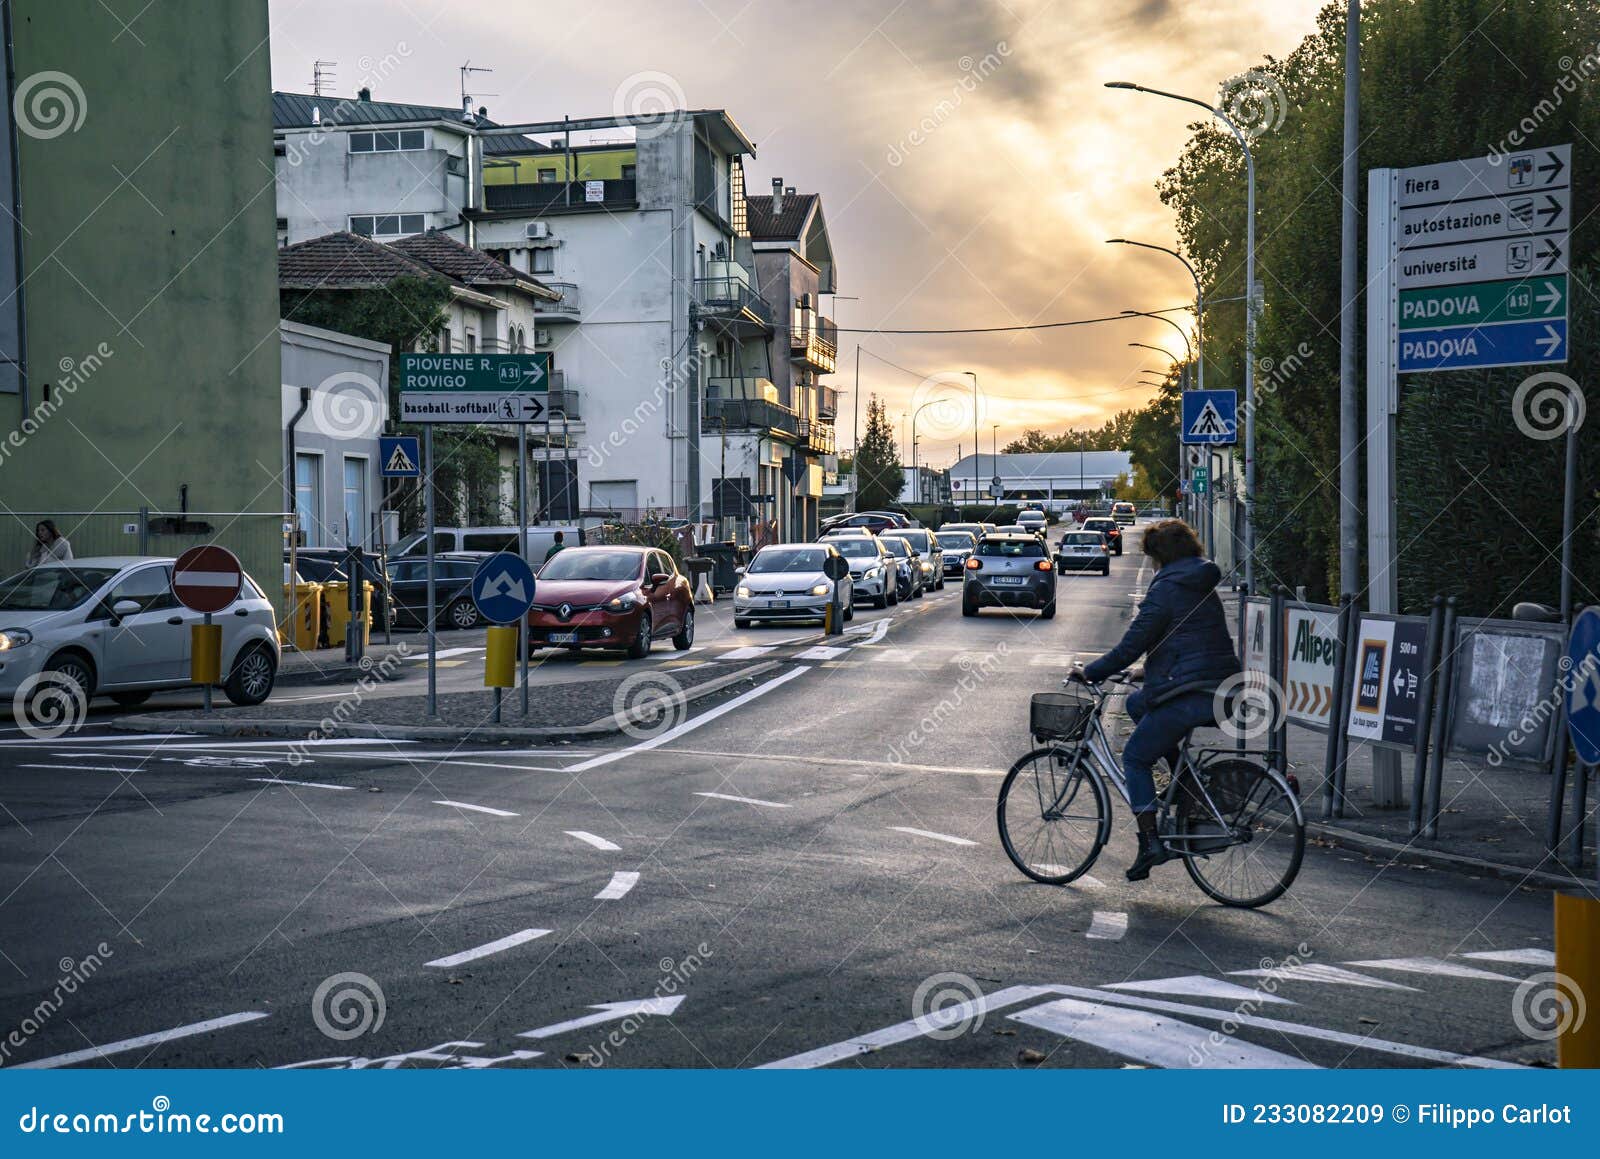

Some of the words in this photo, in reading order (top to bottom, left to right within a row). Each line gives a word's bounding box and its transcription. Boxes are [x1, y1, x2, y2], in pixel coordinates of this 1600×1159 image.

[1405, 178, 1440, 194] fiera
[1405, 212, 1502, 235] autostazione
[1403, 295, 1480, 319] PADOVA
[1403, 337, 1479, 360] PADOVA
[406, 358, 475, 371] PIOVENE
[480, 358, 494, 371] R.
[407, 375, 467, 388] ROVIGO
[404, 402, 498, 414] baseball-softball
[1400, 642, 1411, 654] 500
[1361, 684, 1378, 699] ALDI
